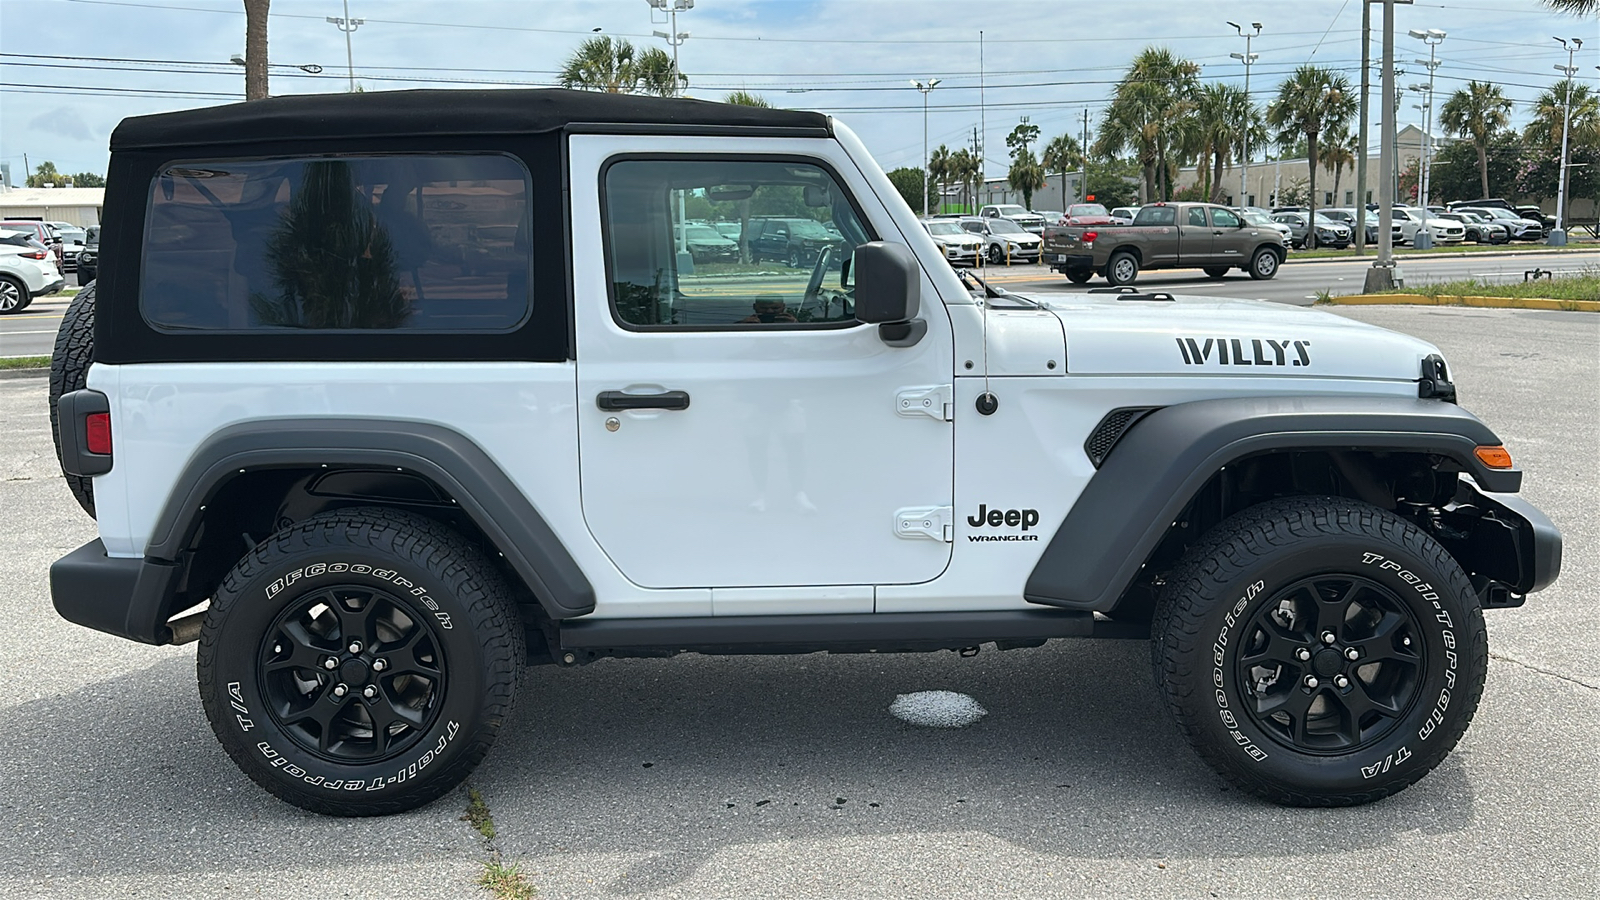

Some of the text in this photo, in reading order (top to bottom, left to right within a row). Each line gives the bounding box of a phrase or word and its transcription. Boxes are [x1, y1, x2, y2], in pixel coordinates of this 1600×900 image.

[1175, 337, 1310, 366] WILLYS
[967, 503, 1040, 531] Jeep
[967, 535, 1039, 543] WRANGLER
[265, 563, 453, 630] BFGoodrich
[1212, 579, 1265, 762] BFGoodrich
[1361, 552, 1457, 779] Trail-Terrain T/A
[227, 681, 460, 791] Trail-Terrain T/A
